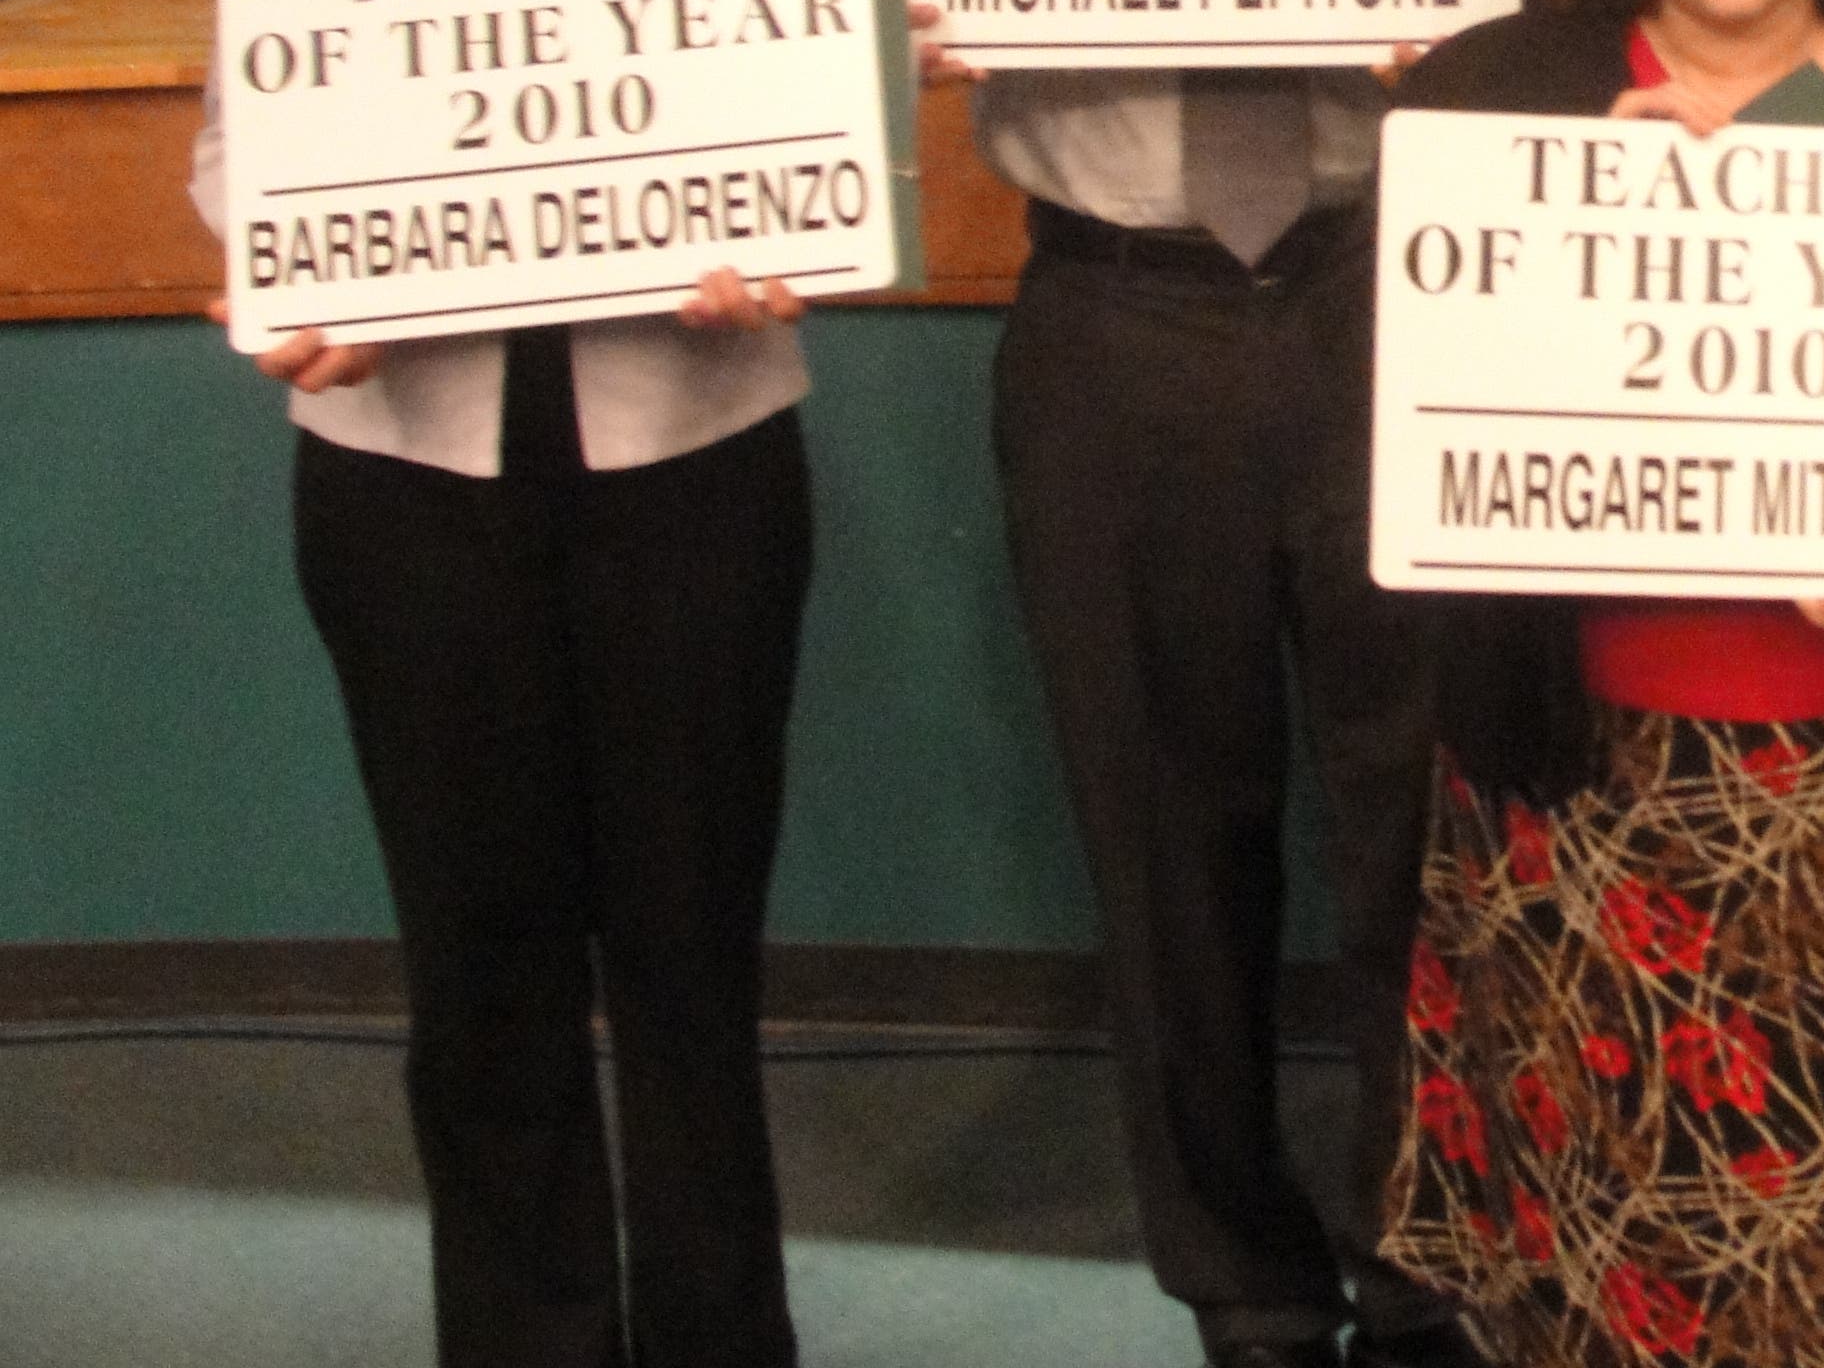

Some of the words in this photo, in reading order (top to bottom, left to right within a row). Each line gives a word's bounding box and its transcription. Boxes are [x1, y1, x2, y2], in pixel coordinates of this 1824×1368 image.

[243, 26, 353, 94] OF
[387, 5, 569, 78] THE
[449, 72, 656, 150] 2010
[248, 197, 515, 290] BARBARA
[533, 158, 869, 259] DELORENZO
[1404, 224, 1525, 295] OF
[1563, 231, 1755, 307] THE
[1439, 450, 1735, 534] MARGARET
